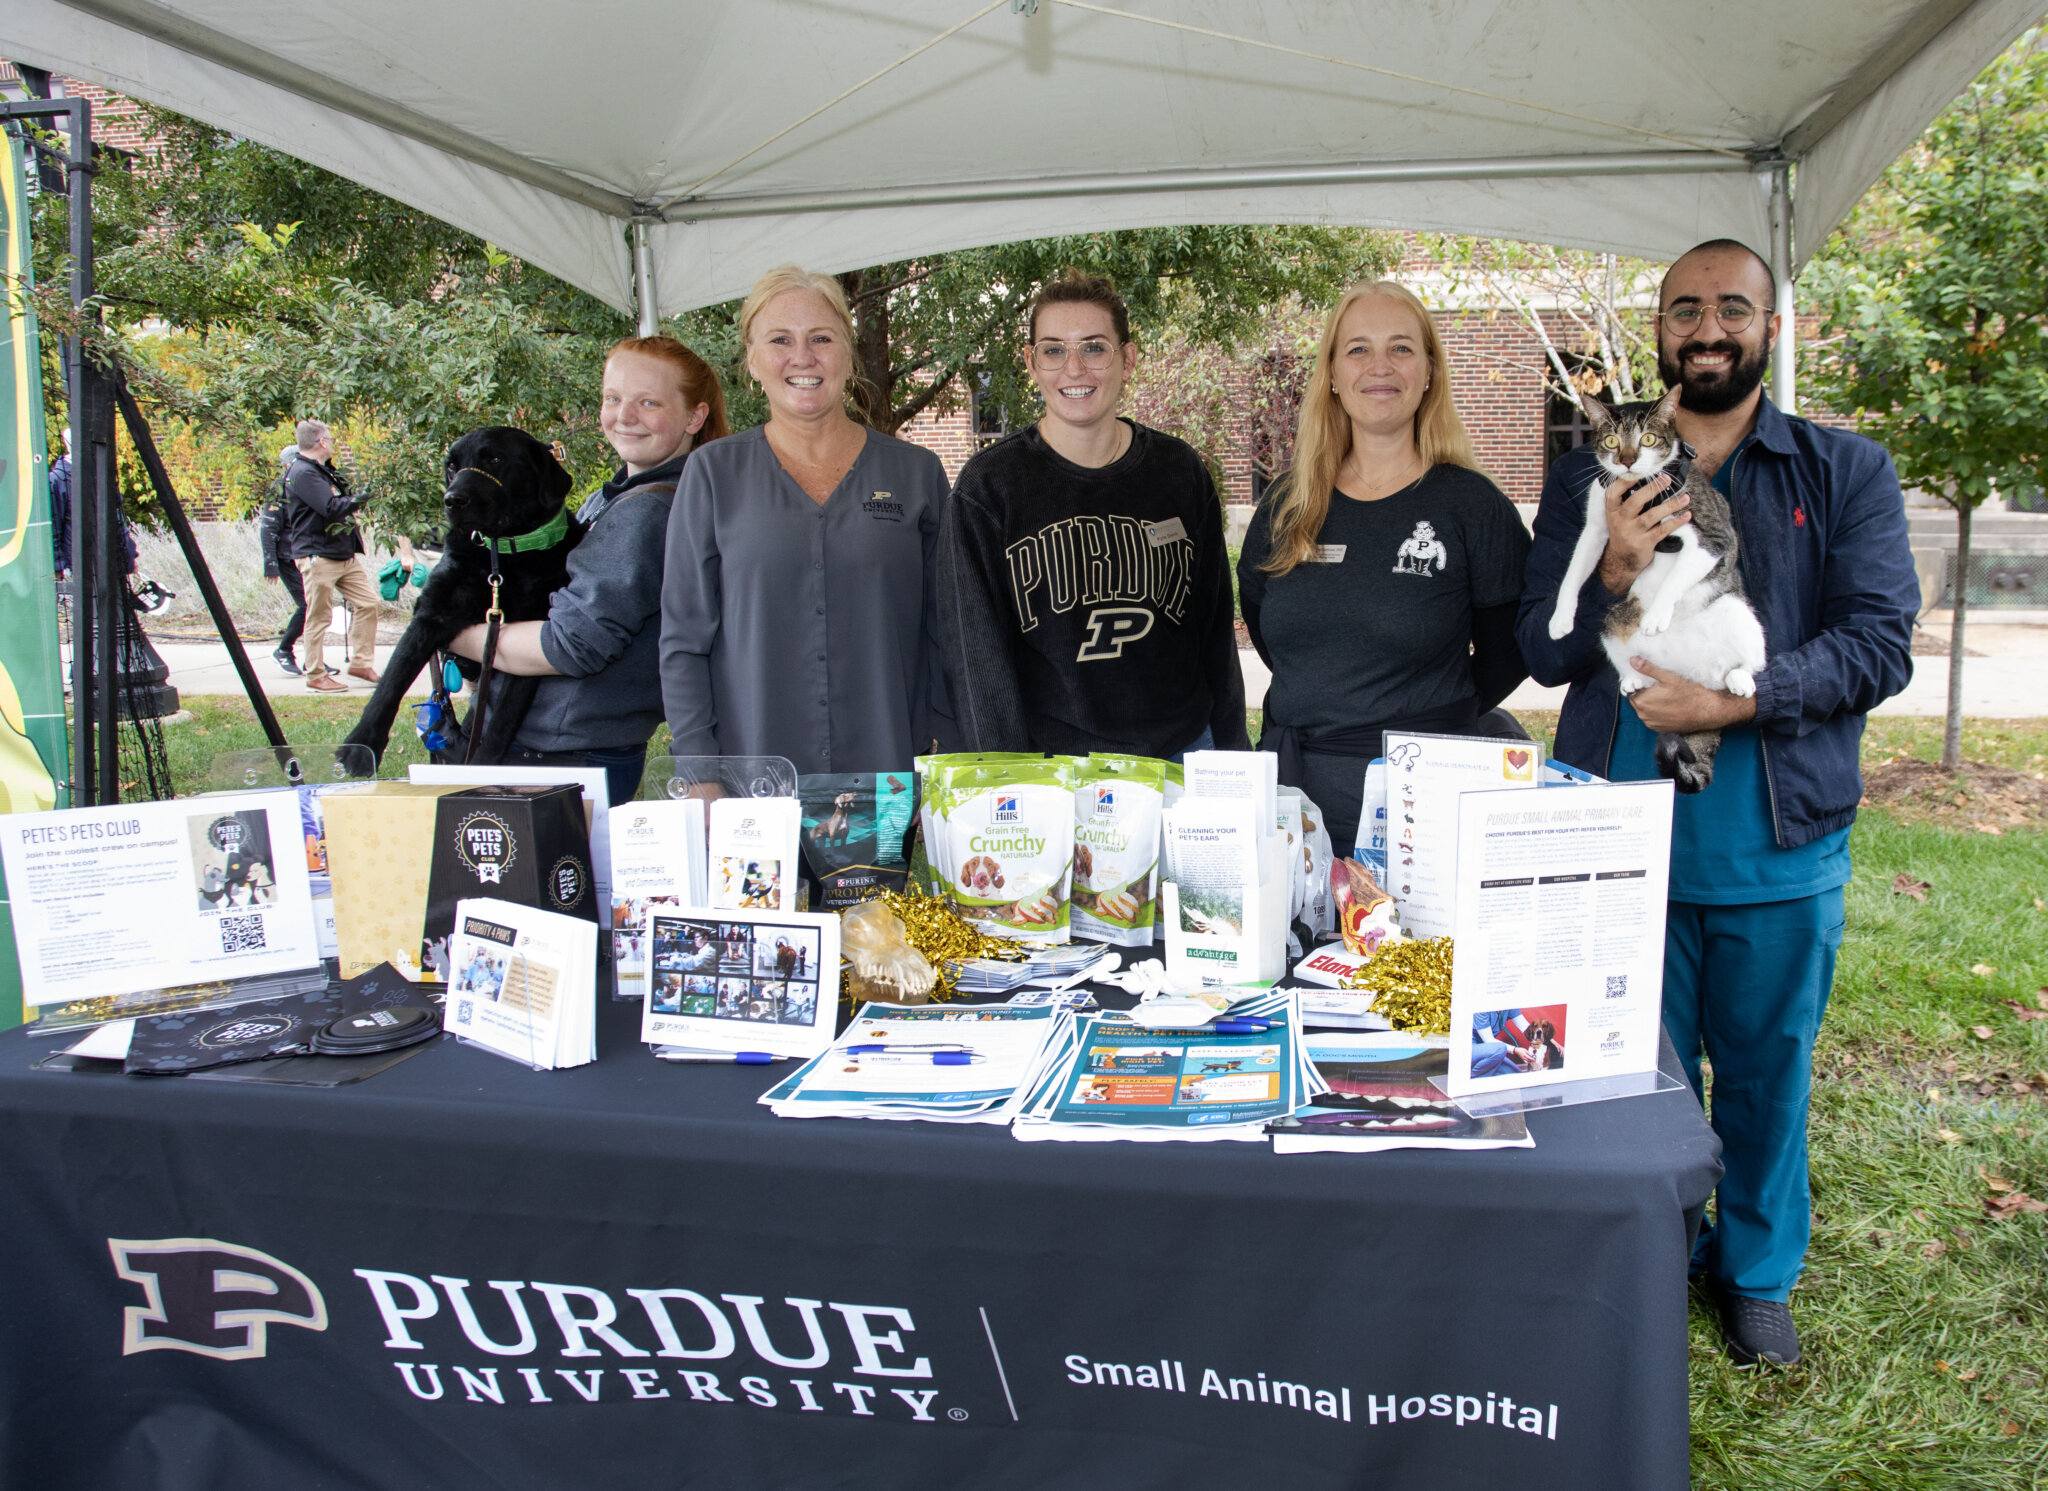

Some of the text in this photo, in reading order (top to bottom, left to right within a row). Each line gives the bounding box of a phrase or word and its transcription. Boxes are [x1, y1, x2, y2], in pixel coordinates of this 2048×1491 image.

[862, 501, 904, 512] PURDUE
[1418, 540, 1430, 551] P
[1005, 514, 1195, 633] PURDUE
[1076, 607, 1155, 662] P
[1195, 768, 1219, 777] Bathing
[996, 812, 1018, 821] Hill's
[1486, 805, 1645, 826] PURDUE SMALL ANIMAL PRIMARY CARE
[21, 819, 141, 845] PETE'S PETS CLUB
[219, 831, 241, 841] PETS
[466, 828, 503, 843] PETE'S
[985, 826, 1030, 835] Grain Free
[1074, 825, 1131, 851] Crunchy
[25, 851, 44, 860] Join
[46, 849, 61, 858] the
[64, 847, 99, 856] coolest
[101, 844, 124, 852] crew
[126, 842, 138, 850] on
[472, 842, 502, 856] PETS
[969, 834, 1047, 855] Crunchy
[558, 869, 570, 900] PETE'S
[566, 868, 577, 894] PETS
[845, 876, 875, 886] PURINA
[827, 886, 854, 899] PRO
[199, 910, 222, 918] JOIN
[465, 920, 493, 938] PRIORITY
[495, 927, 512, 943] PAWS
[1187, 949, 1235, 961] advantage
[1306, 955, 1360, 977] Elanc
[107, 1237, 329, 1361] P
[353, 1268, 933, 1379] PURDUE
[394, 1361, 939, 1422] UNIVERSITY
[1064, 1354, 1560, 1441] Small Animal Hospital
